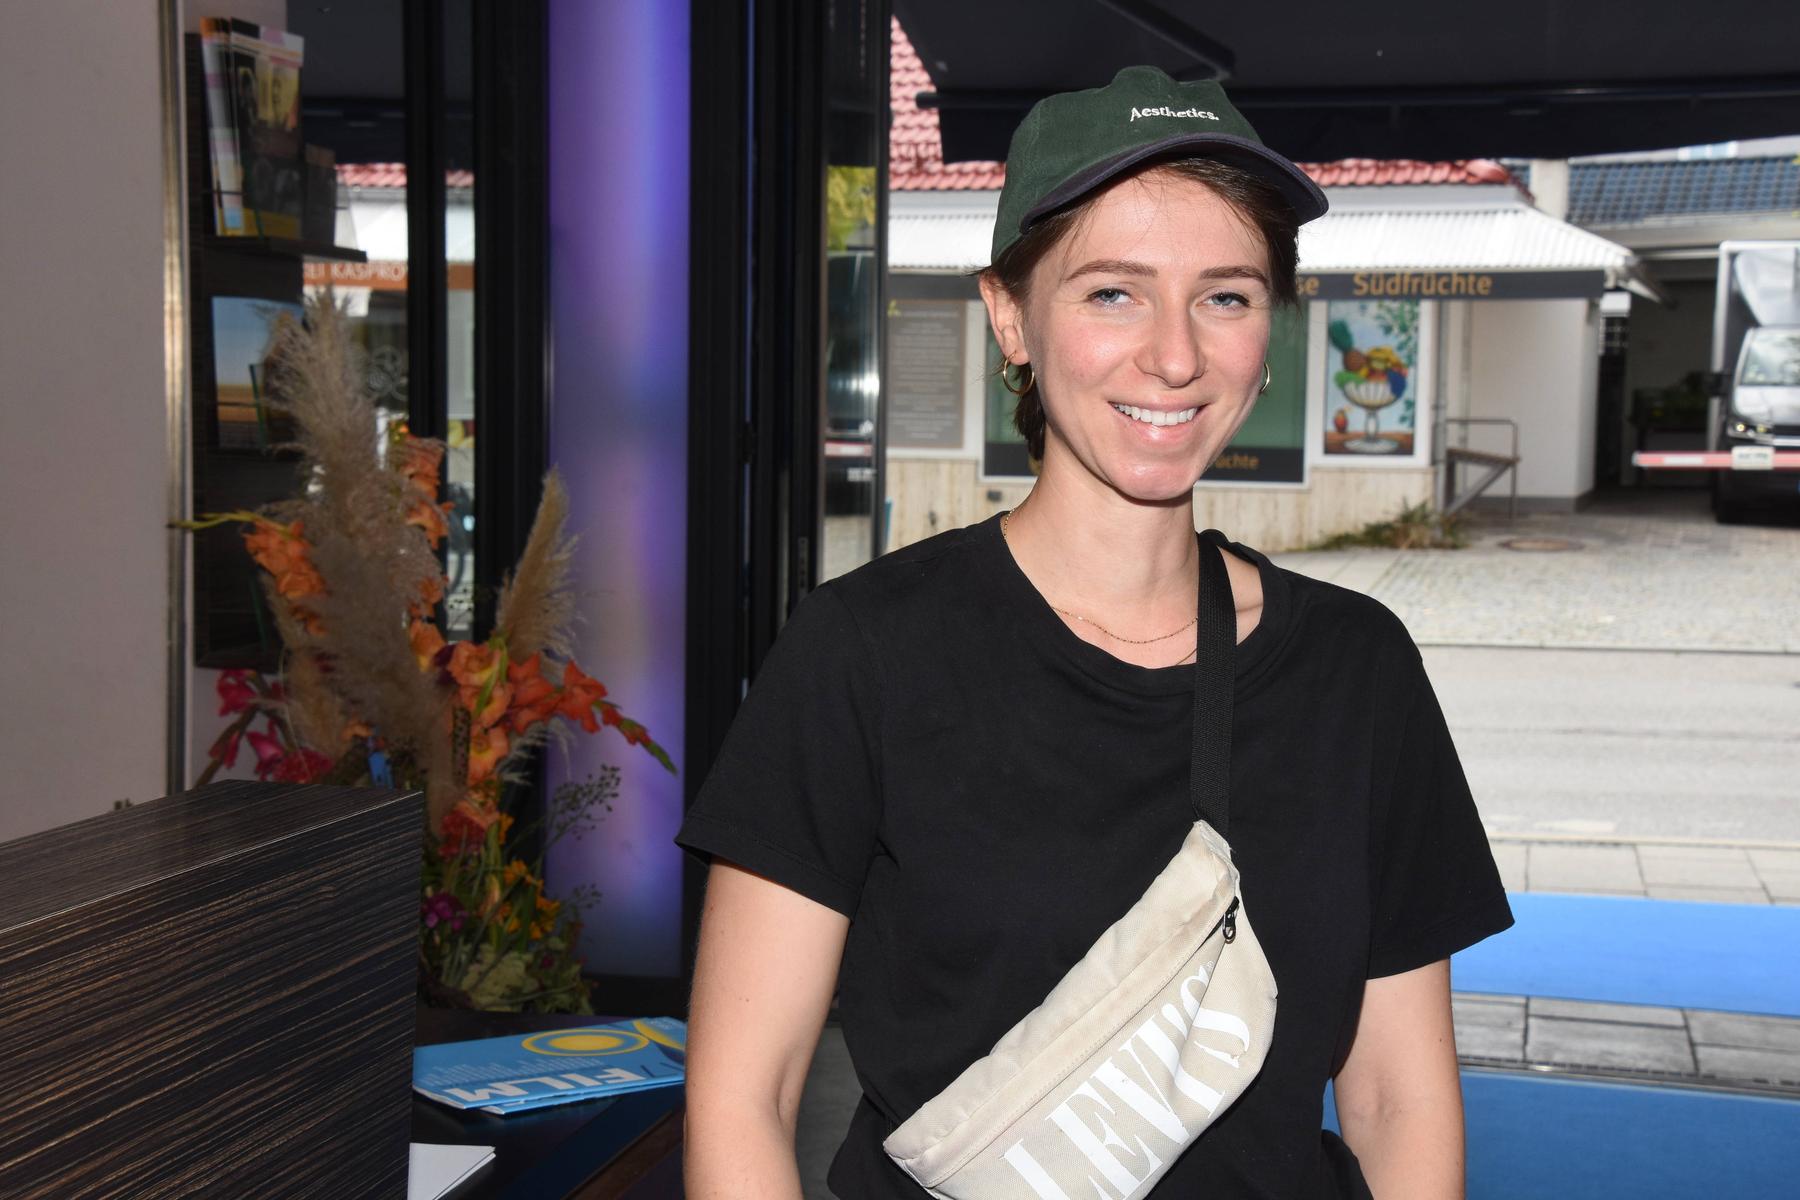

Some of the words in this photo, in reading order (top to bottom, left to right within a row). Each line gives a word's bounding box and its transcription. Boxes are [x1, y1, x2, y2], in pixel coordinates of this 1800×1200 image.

[1129, 106, 1220, 122] Aesthetics.
[330, 260, 408, 281] KASPRO
[1353, 270, 1493, 297] Südfrüchte
[443, 1067, 646, 1103] FILM
